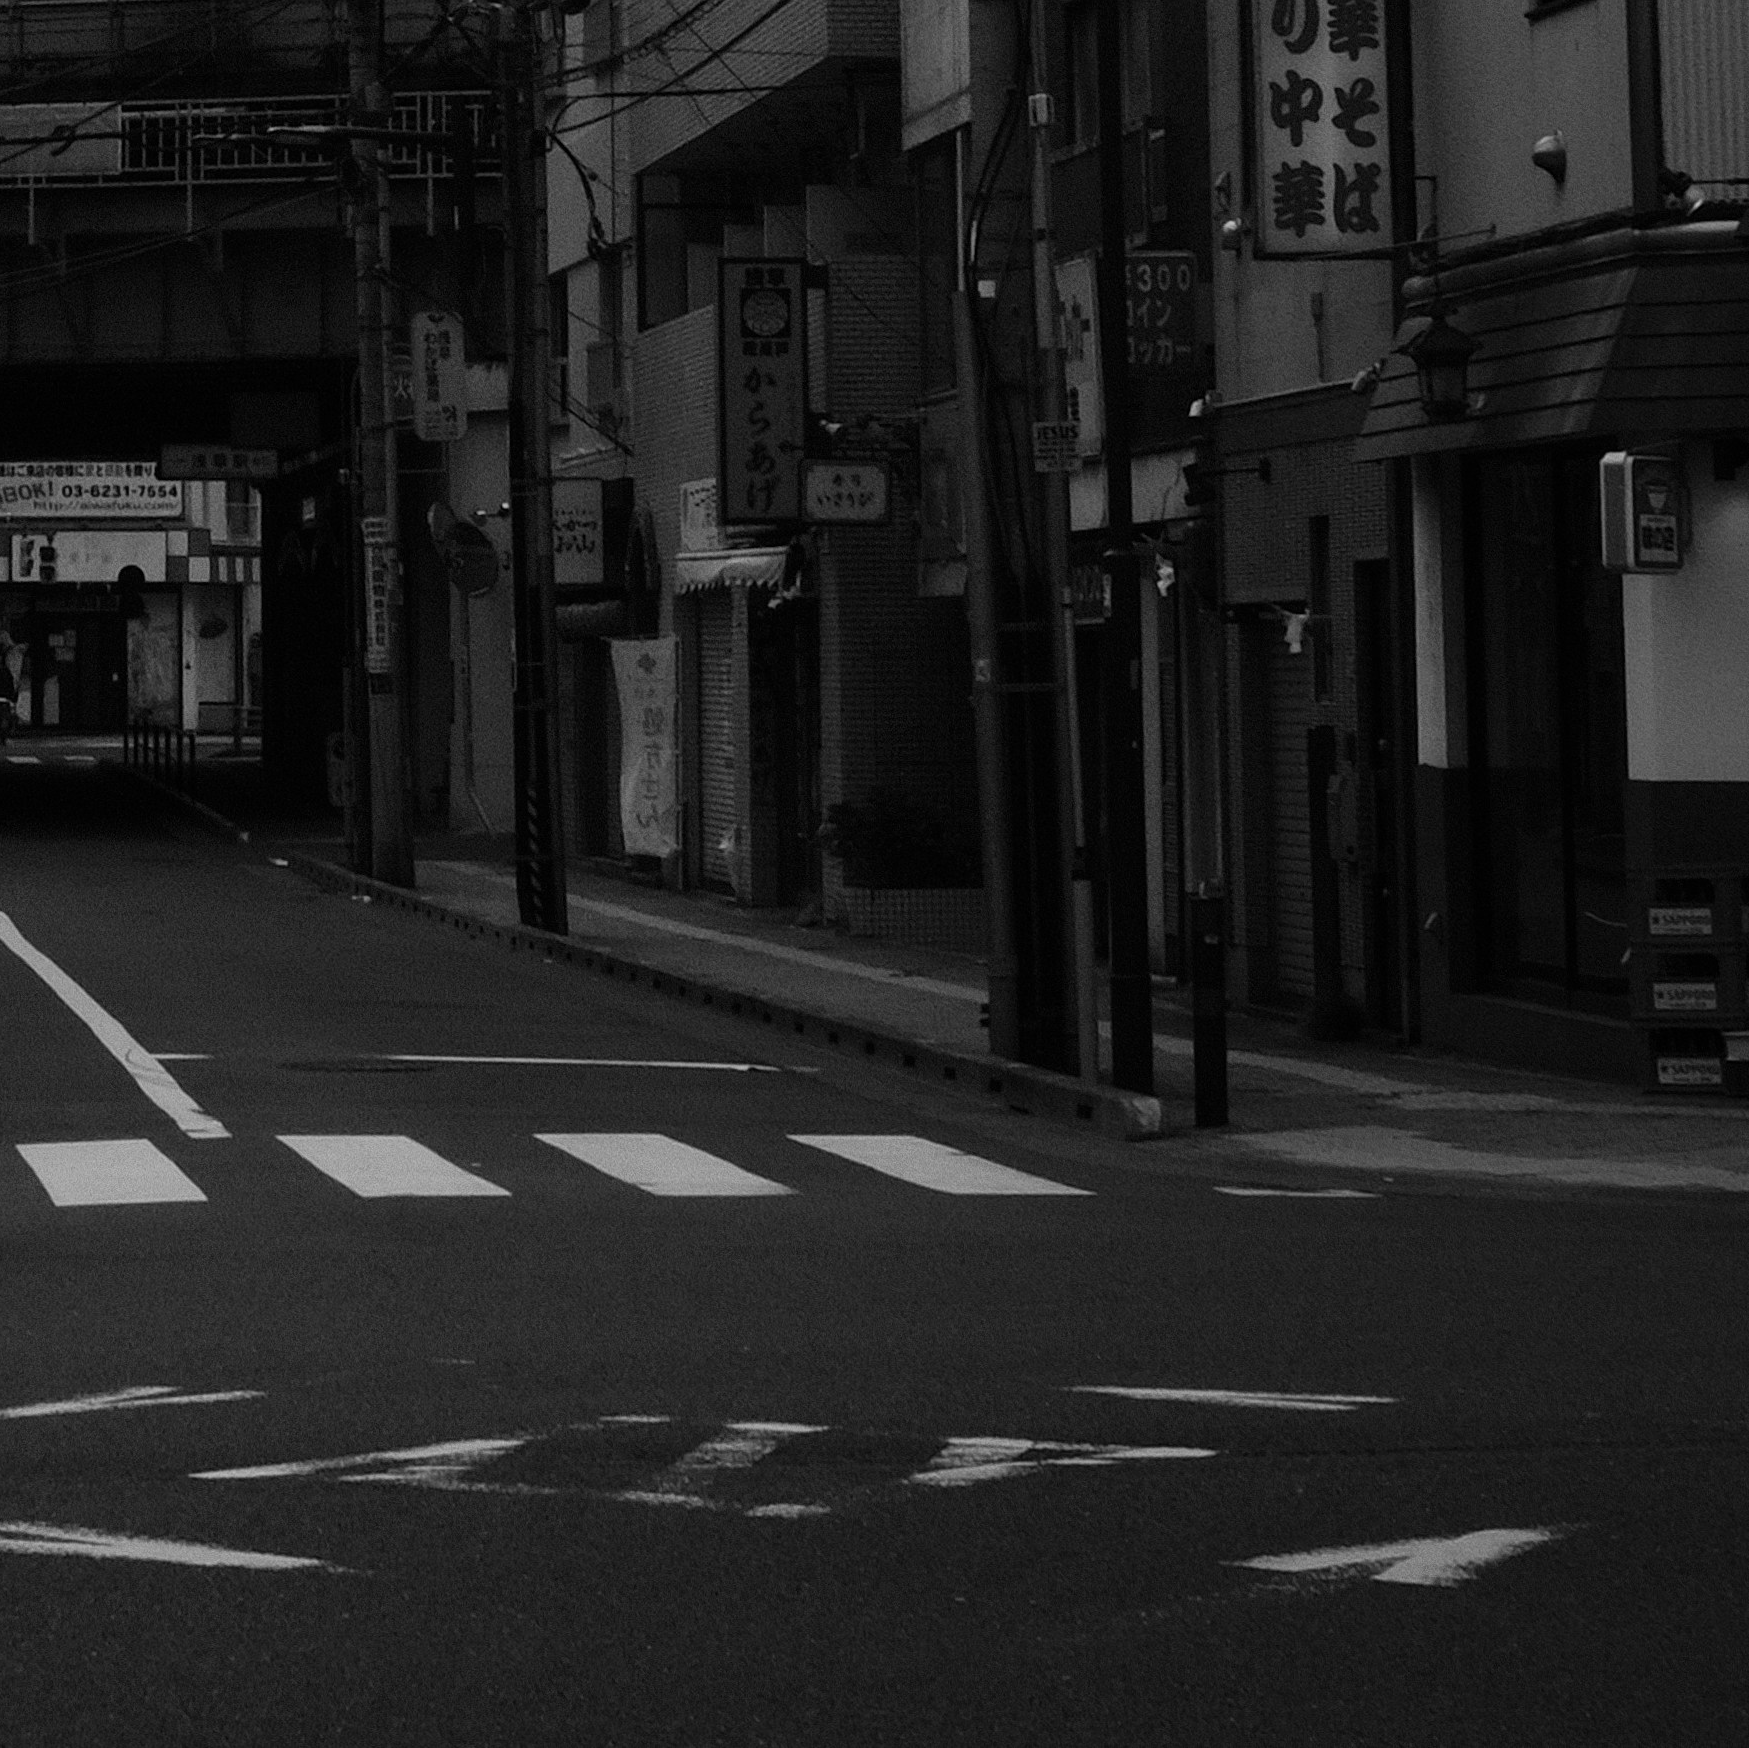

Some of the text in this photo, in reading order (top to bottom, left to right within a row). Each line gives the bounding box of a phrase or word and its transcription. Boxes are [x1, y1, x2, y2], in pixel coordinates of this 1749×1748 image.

[744, 365, 780, 513] からあげ
[1037, 425, 1078, 440] JESUS
